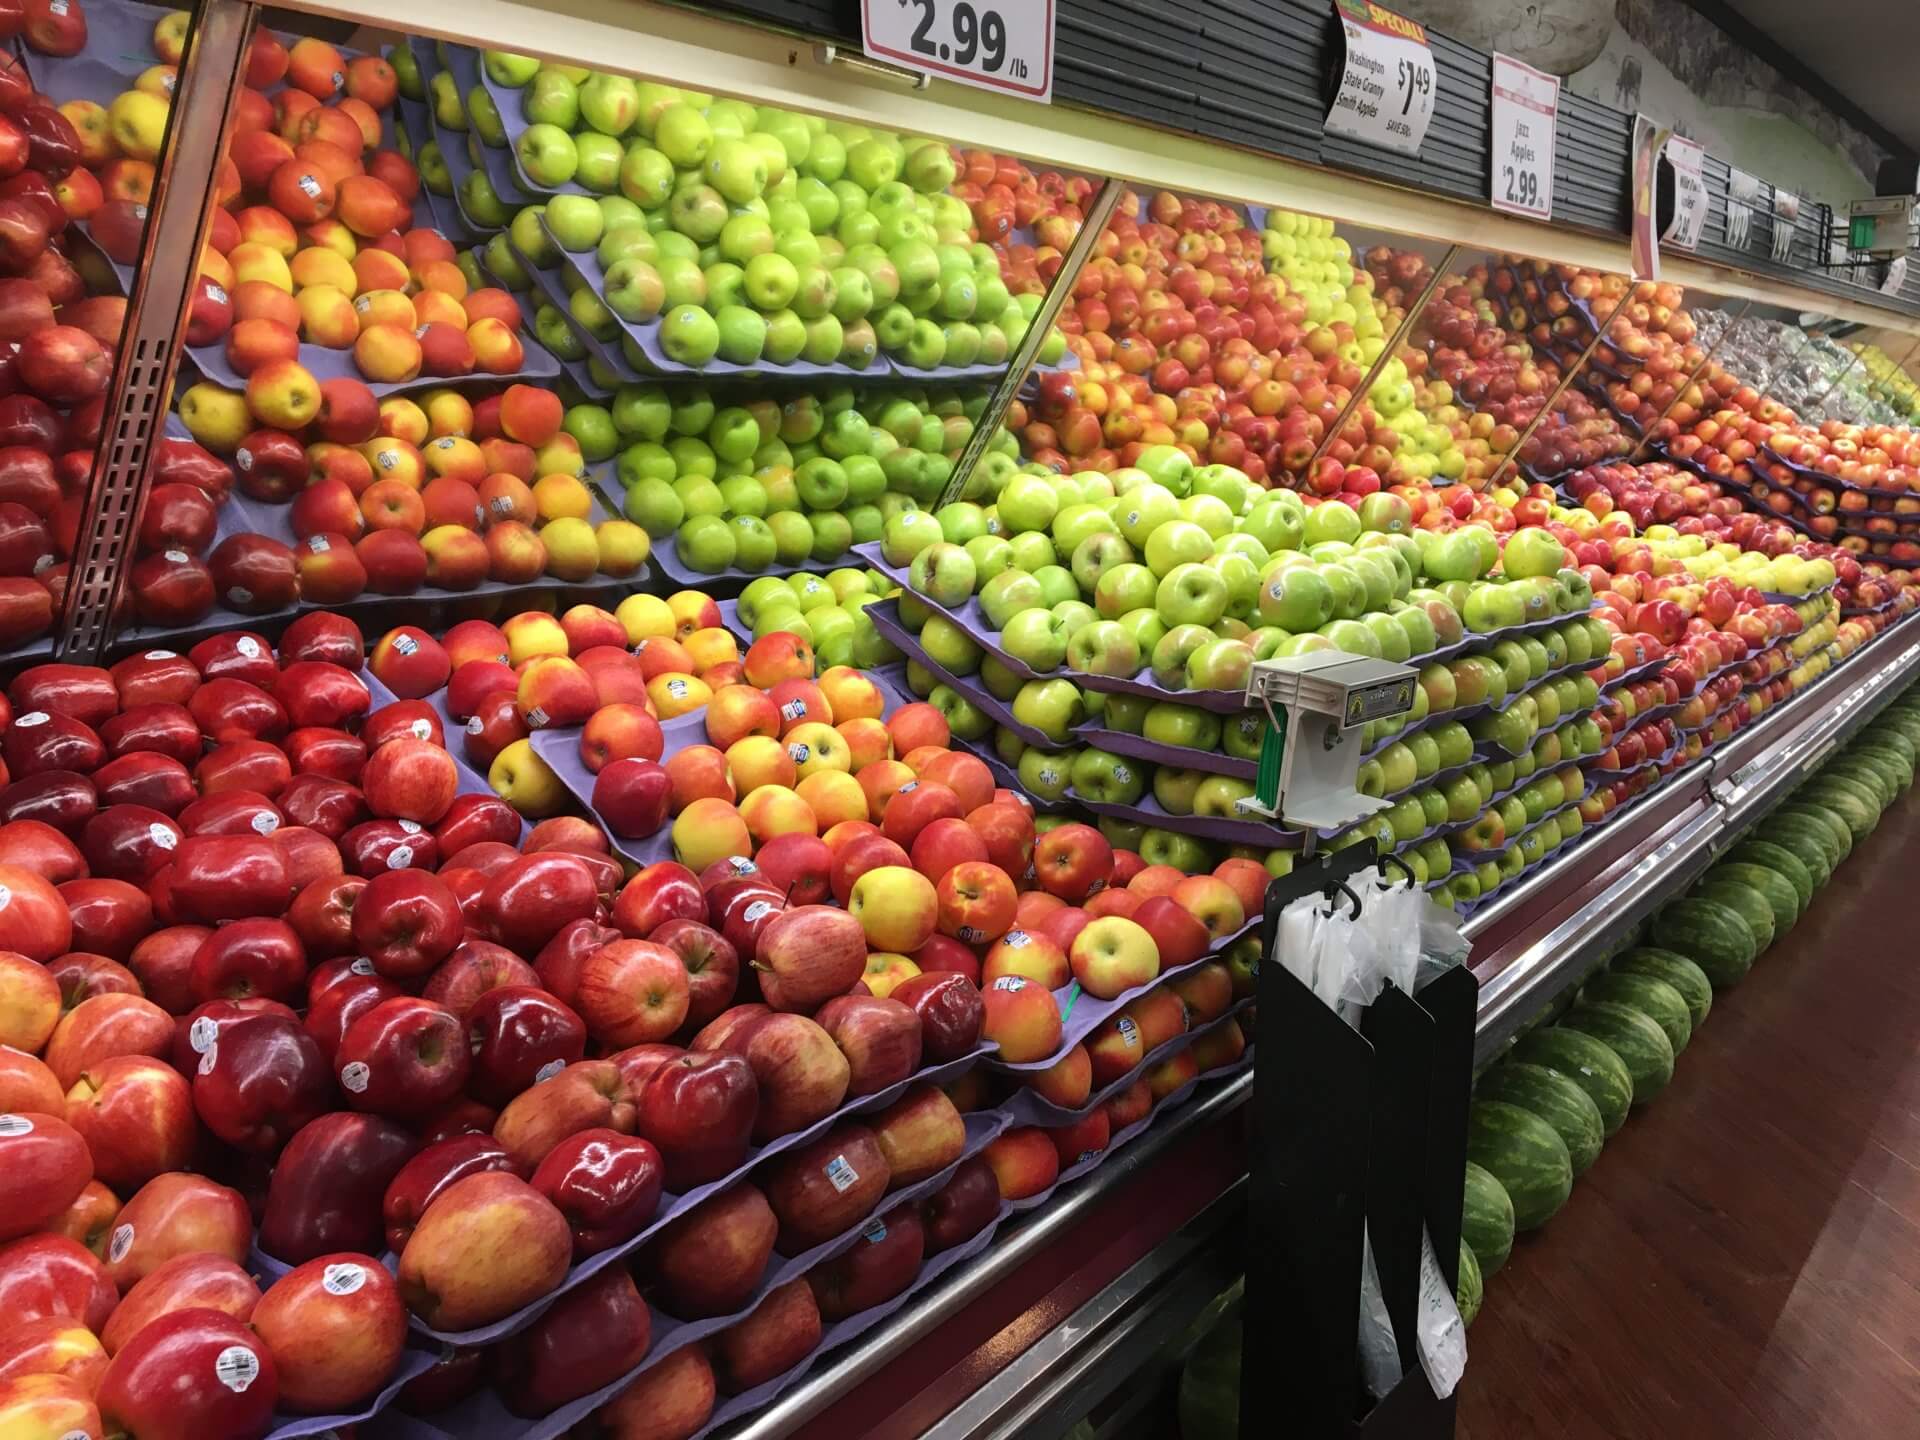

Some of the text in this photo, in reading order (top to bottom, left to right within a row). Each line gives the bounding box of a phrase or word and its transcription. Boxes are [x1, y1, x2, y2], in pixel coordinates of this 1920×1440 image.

[901, 0, 1028, 80] 2.99 /lb
[1348, 48, 1385, 75] Washington
[1344, 70, 1385, 100] State Granny
[1336, 92, 1379, 118] Smith Apples
[1515, 120, 1530, 139] Jazz
[1510, 140, 1535, 164] Apples
